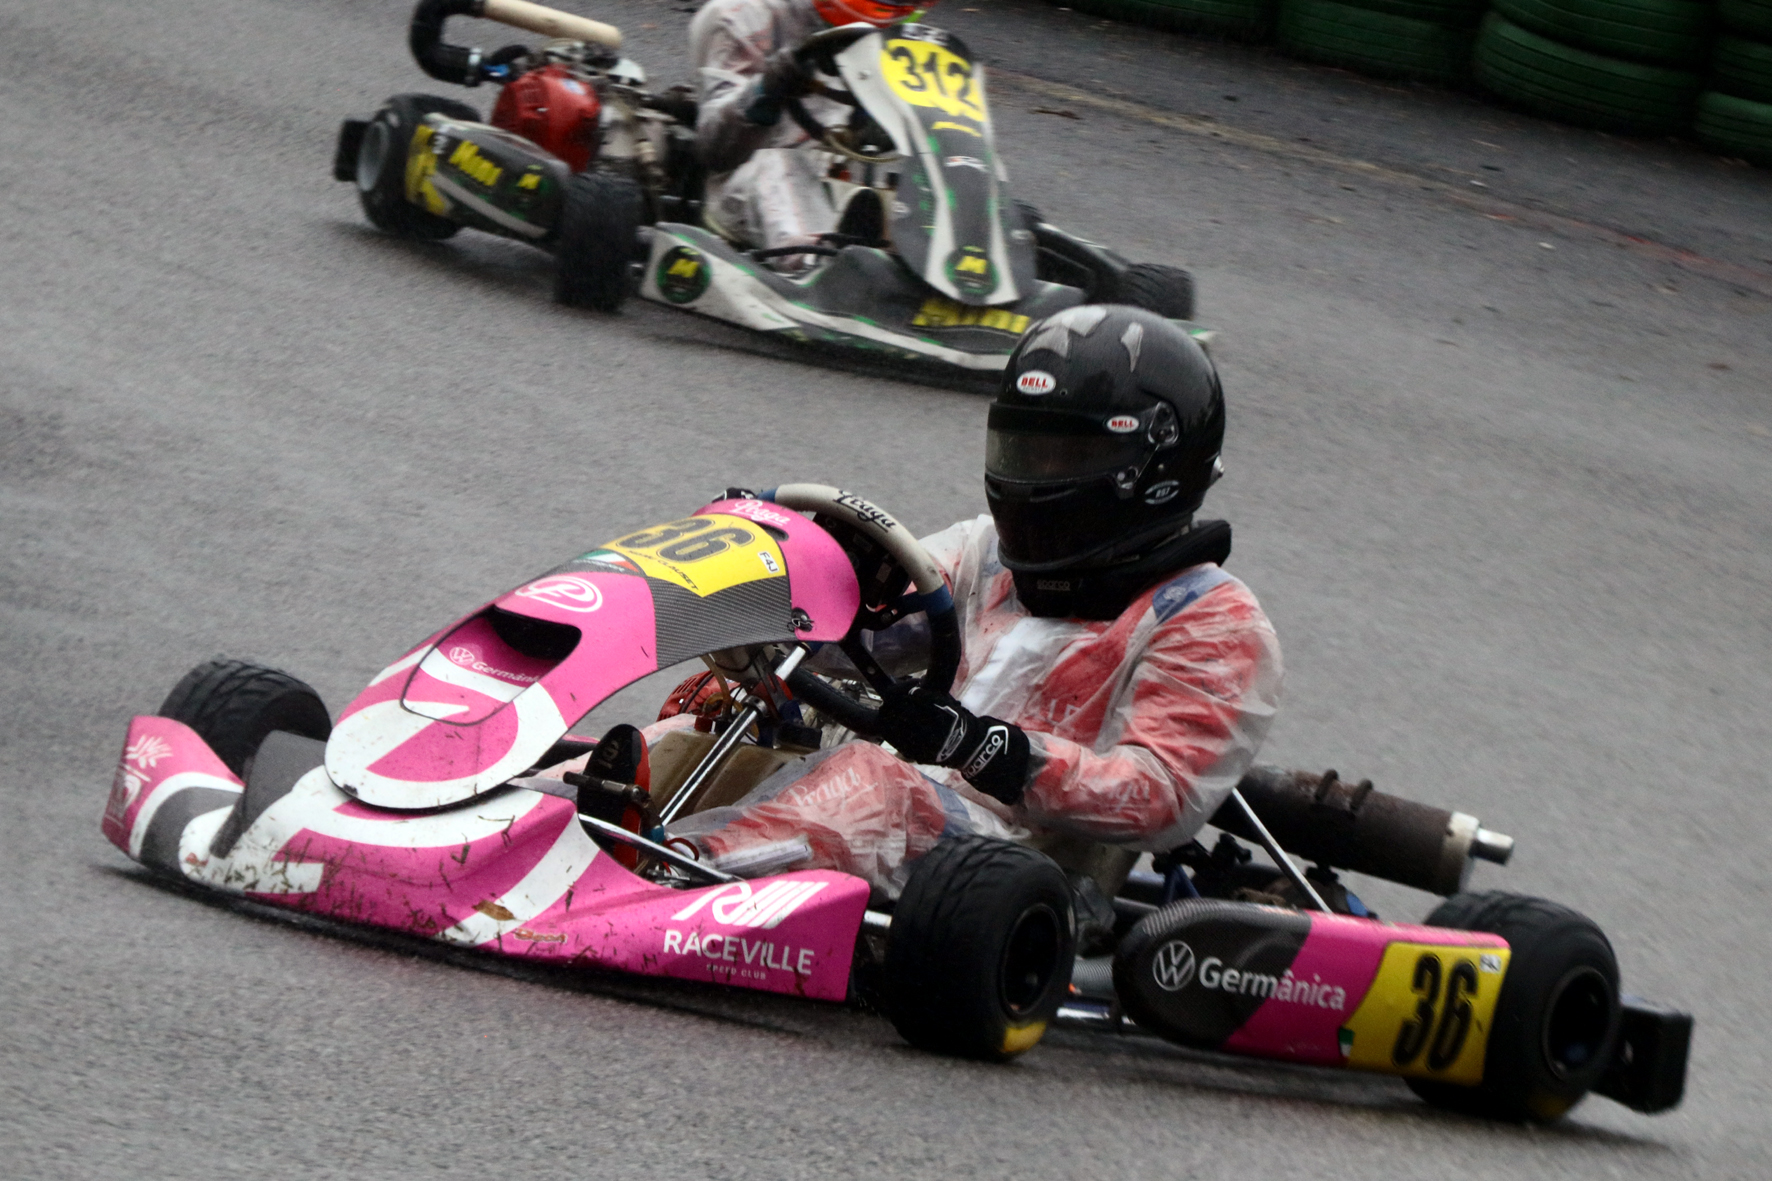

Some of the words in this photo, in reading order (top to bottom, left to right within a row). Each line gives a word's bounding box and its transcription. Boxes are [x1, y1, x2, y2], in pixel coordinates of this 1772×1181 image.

[889, 46, 980, 110] 312
[1021, 376, 1049, 389] BELL
[1111, 419, 1136, 428] BELL
[729, 499, 791, 527] Praga
[615, 517, 756, 564] 36
[759, 551, 779, 573] F4J
[663, 929, 816, 976] RACEVILLE
[740, 969, 767, 980] CLUB
[1198, 955, 1347, 1012] Germânica
[1391, 951, 1480, 1072] 36
